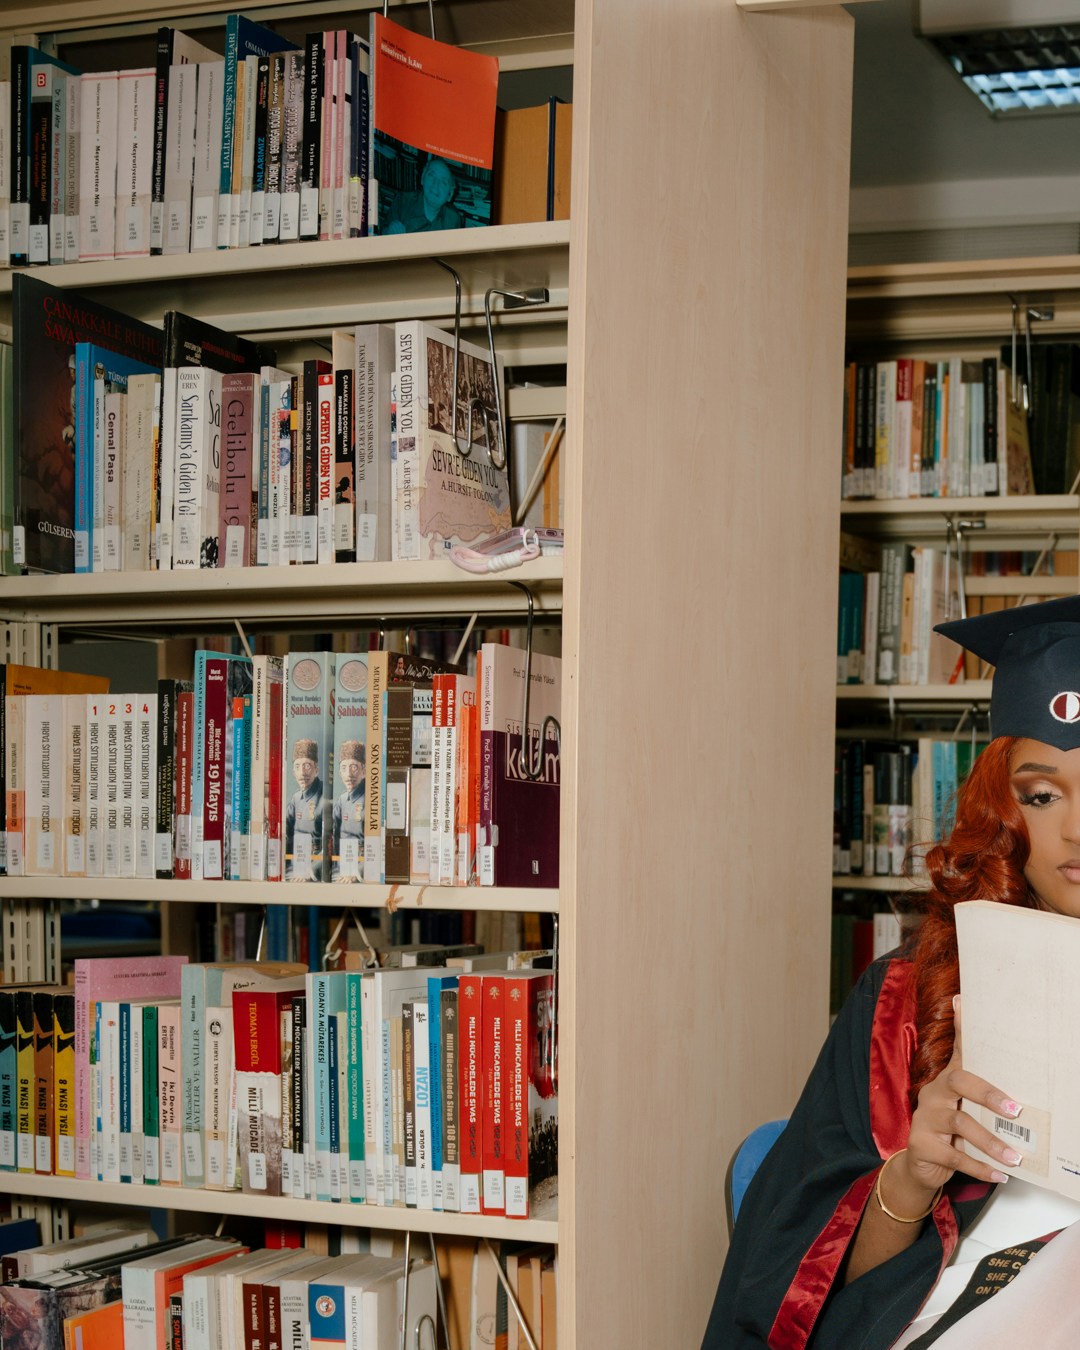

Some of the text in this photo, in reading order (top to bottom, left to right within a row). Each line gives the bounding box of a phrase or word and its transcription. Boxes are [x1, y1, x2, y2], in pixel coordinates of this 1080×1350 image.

[228, 33, 236, 73] ANILARI
[310, 43, 318, 85] Mütareke
[179, 372, 200, 382] ÖZHAN
[181, 382, 198, 390] EREN
[399, 334, 415, 433] SEVR'E GİDEN YOL
[106, 412, 116, 484] Cemal Paşa
[176, 394, 199, 494] Sarıkamış'a Giden
[225, 399, 246, 495] Gelibolu
[320, 400, 332, 500] CEPHEYE GİDEN YOL
[432, 449, 499, 489] SEVR'E GİDEN YOL
[38, 521, 76, 539] GÜLSEREN
[484, 665, 492, 699] Sistematik
[93, 706, 97, 716] 1
[108, 704, 116, 715] 2
[125, 704, 132, 714] 3
[142, 703, 149, 713] 4
[290, 704, 322, 717] Şahbaba
[484, 700, 492, 725] Kelâm
[40, 721, 51, 779] KURTULUŞ TARİHİ
[71, 725, 82, 783] KURTULUŞ TARİHİ
[89, 722, 99, 781] KURTULUŞ TARİHİ
[107, 724, 118, 783] KURTULUŞ TARİHİ
[122, 720, 133, 780] KURTULUŞ TARİHİ
[140, 721, 151, 780] KURTULUŞ TARİHİ
[369, 666, 380, 831] MURAT BARDAKÇI SON OSMANLILAR
[208, 764, 221, 823] 19 Mayıs
[249, 1002, 259, 1067] TEOMAN ERGÜL
[318, 980, 327, 1064] MUDANYA MÜTAREKESİ
[192, 1029, 200, 1082] VE VALİLER
[2, 1085, 11, 1110] İSYAN
[19, 1085, 29, 1110] İSYAN
[37, 1087, 47, 1112] İSYAN
[58, 1087, 68, 1112] İSYAN
[416, 1067, 429, 1108] LOZAN
[493, 1040, 501, 1124] MÜCADELEDE SİVAS
[514, 1043, 522, 1127] MÜCADELEDE SİVAS
[446, 1052, 456, 1161] Mücadelede Sivas 108 Gün
[988, 1258, 1011, 1268] SHE
[1004, 1248, 1028, 1257] SHE
[976, 1286, 991, 1295] ON
[986, 1272, 1007, 1281] SHE
